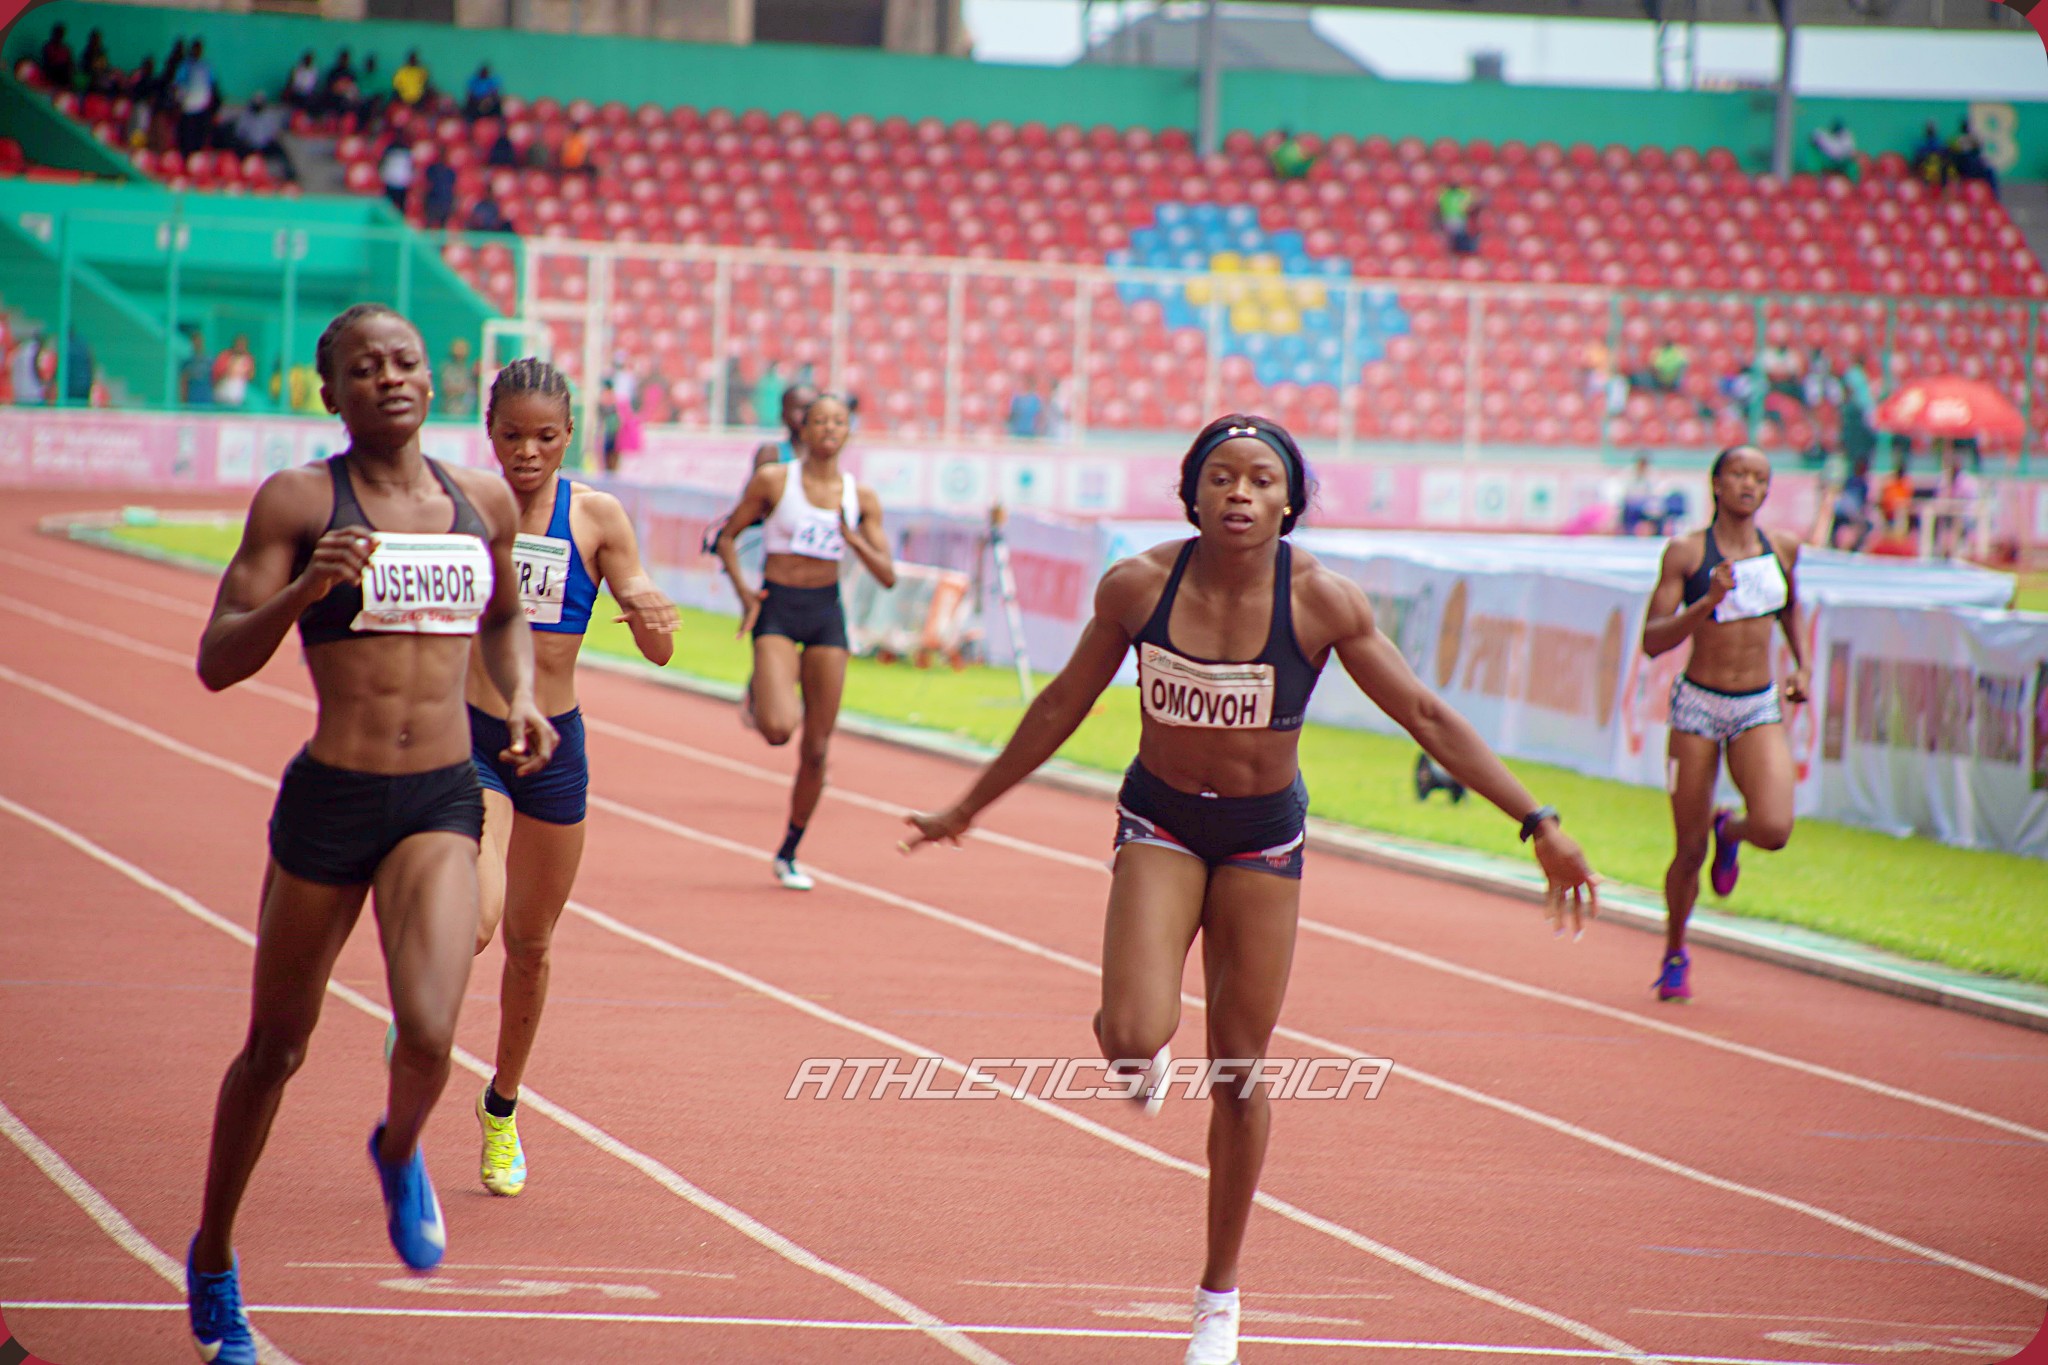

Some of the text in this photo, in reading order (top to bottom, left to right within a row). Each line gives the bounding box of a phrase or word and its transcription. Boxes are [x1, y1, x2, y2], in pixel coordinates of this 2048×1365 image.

[372, 564, 475, 603] USENBOR
[515, 560, 532, 595] R
[1152, 678, 1257, 726] OMOVOH
